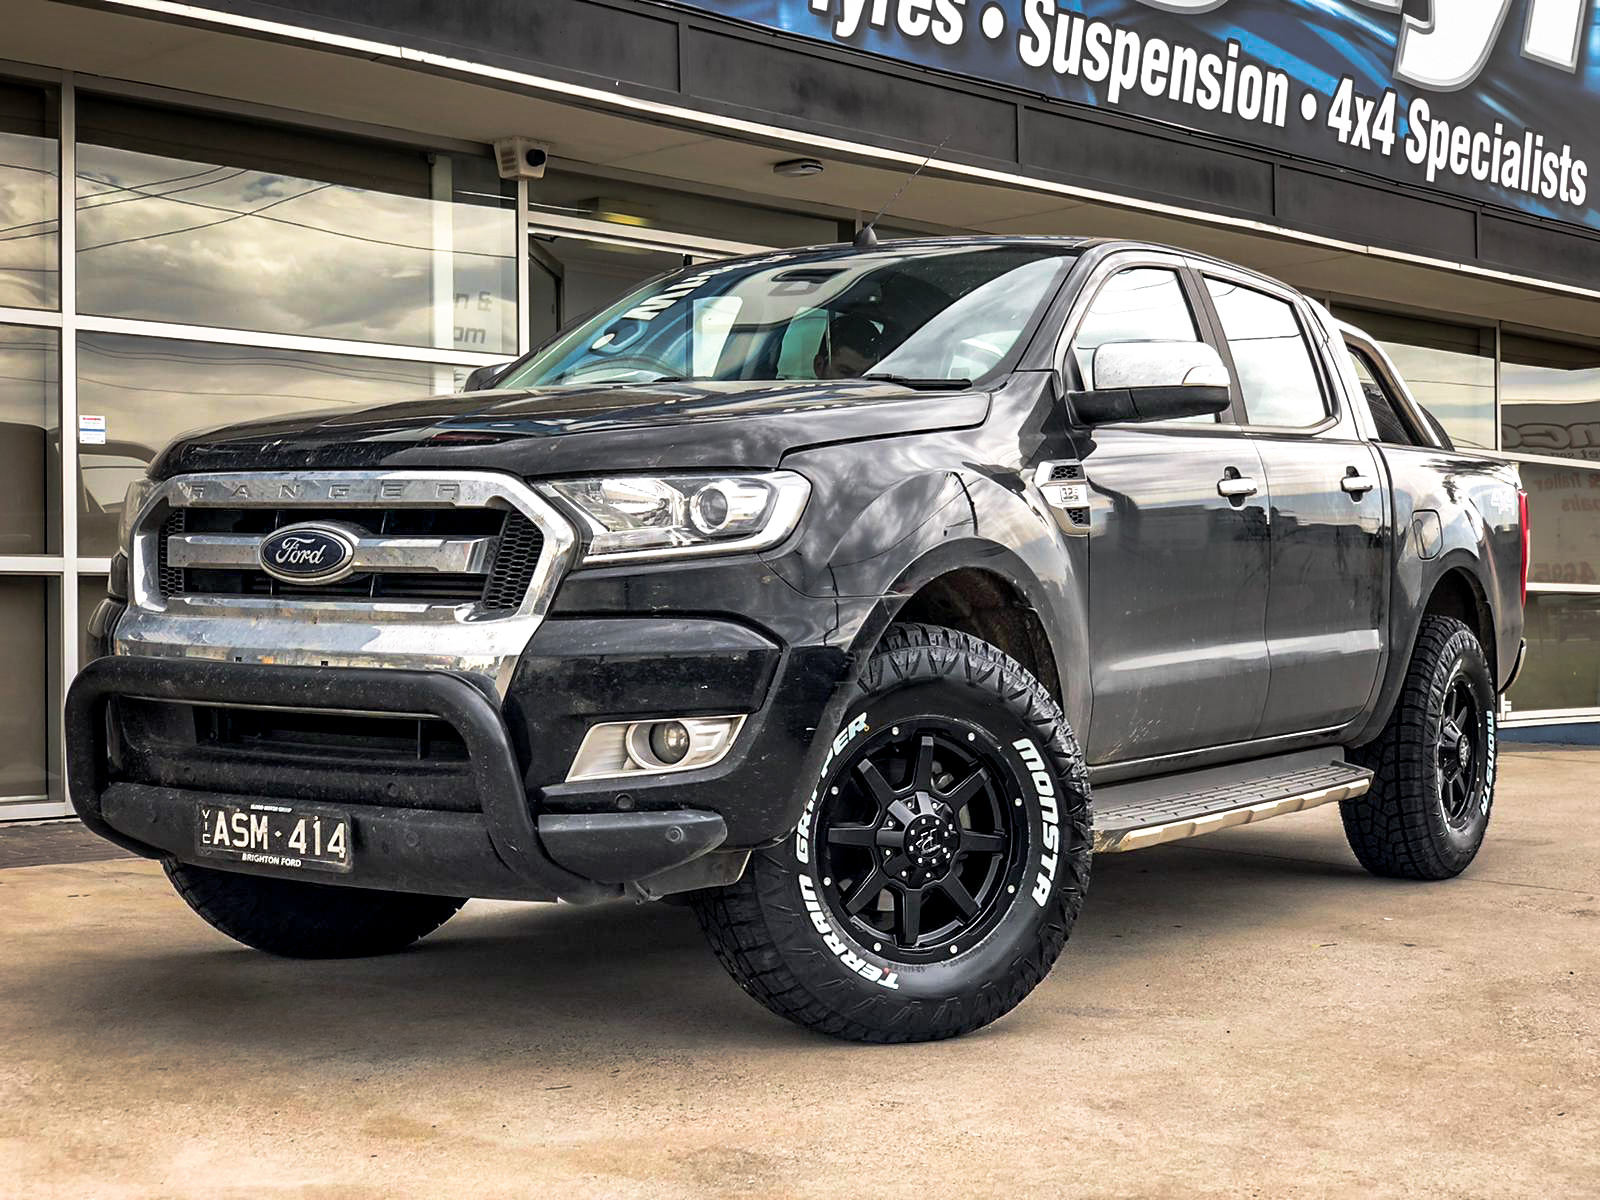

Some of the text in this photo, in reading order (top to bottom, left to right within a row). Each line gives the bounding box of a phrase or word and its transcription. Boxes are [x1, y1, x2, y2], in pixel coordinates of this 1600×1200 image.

[811, 0, 966, 46] yes
[1018, 0, 1290, 128] Suspension
[1327, 76, 1397, 157] 4x4
[1404, 97, 1588, 206] Specialists
[188, 482, 461, 499] RANGER
[275, 536, 327, 564] Ford
[796, 711, 868, 865] GRIER
[201, 809, 211, 844] VIC
[213, 810, 347, 859] ASM 414
[1012, 737, 1059, 908] MONSTA
[241, 852, 302, 868] BRIGHTON FORD
[798, 873, 899, 990] TERRAIN
